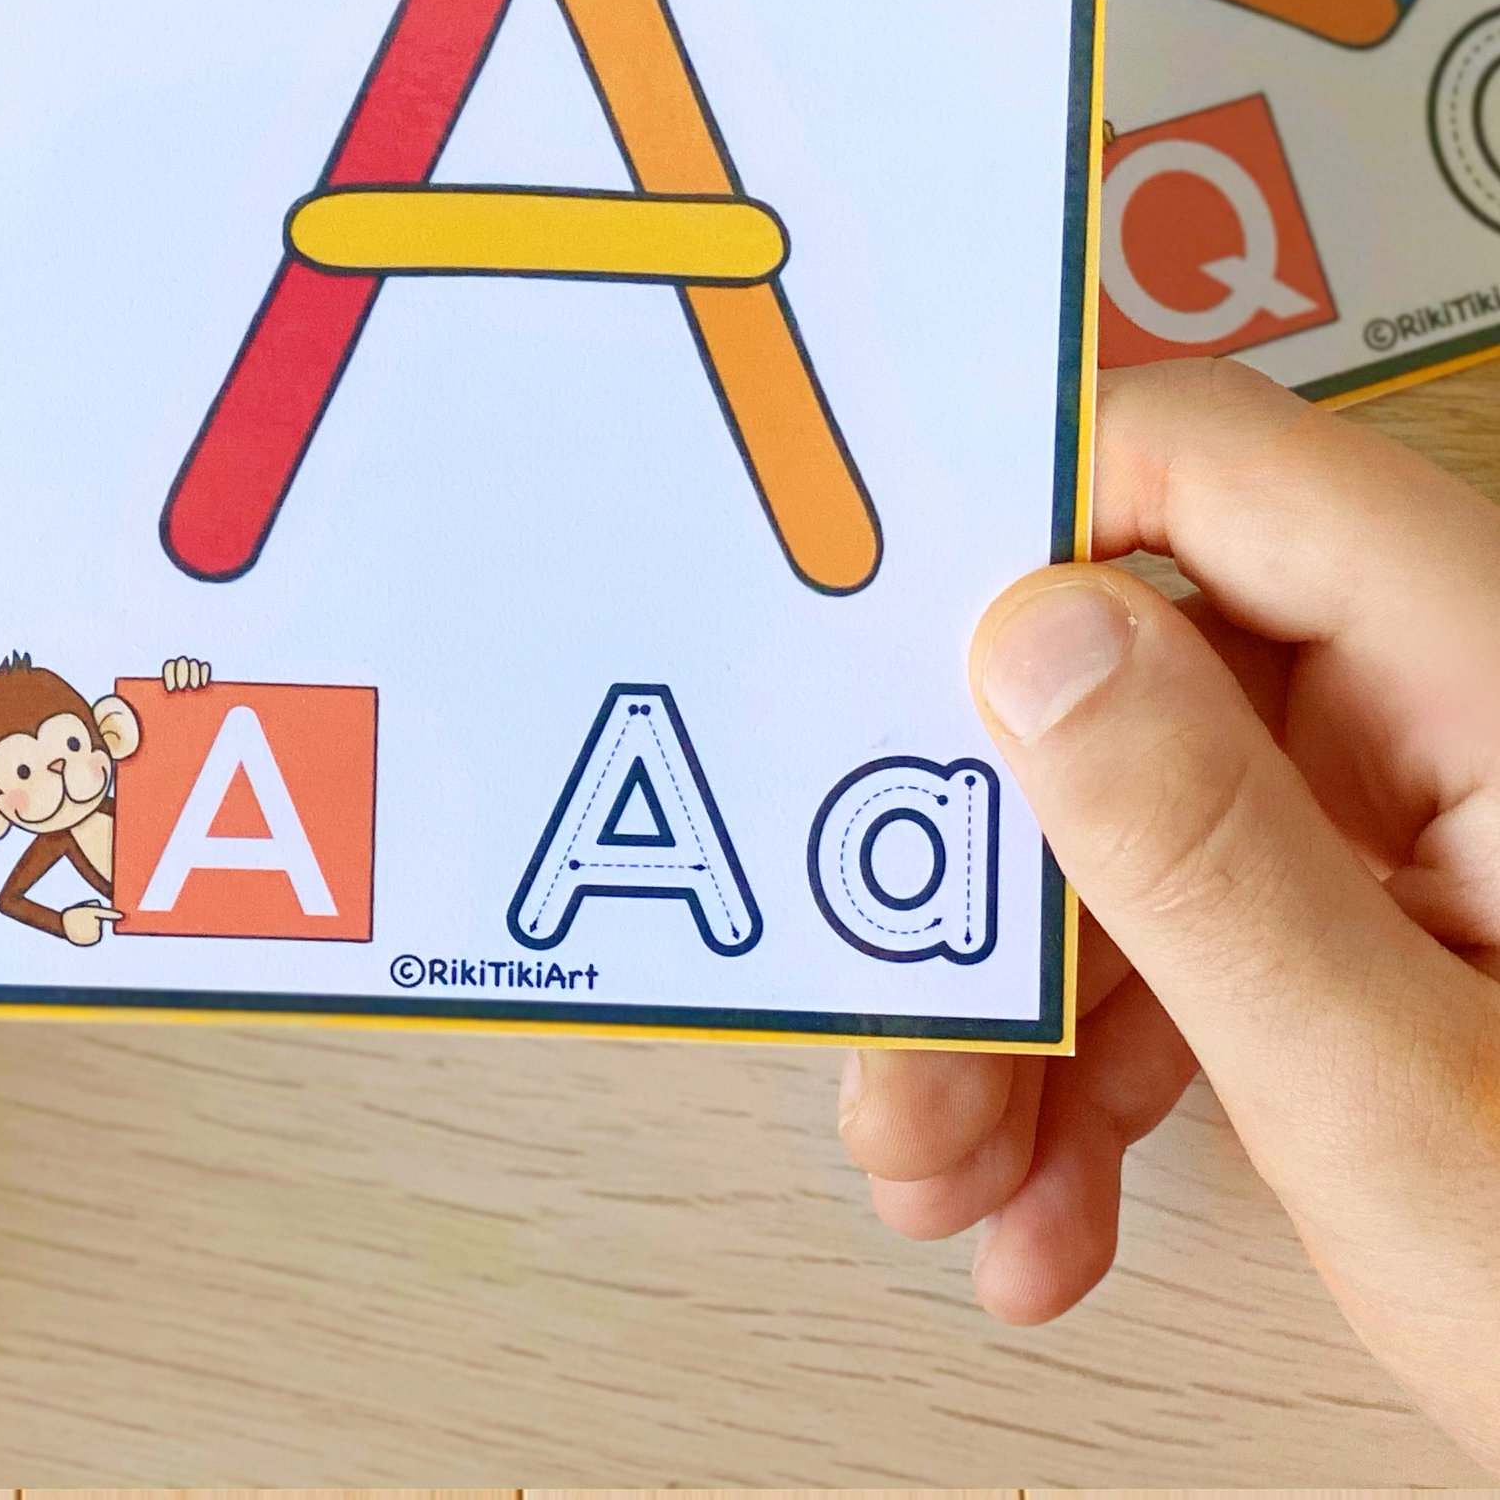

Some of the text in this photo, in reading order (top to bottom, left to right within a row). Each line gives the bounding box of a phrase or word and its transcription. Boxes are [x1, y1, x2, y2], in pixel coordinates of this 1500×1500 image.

[1100, 138, 1320, 345] Q
[138, 706, 340, 916] A
[506, 682, 1000, 965] A a
